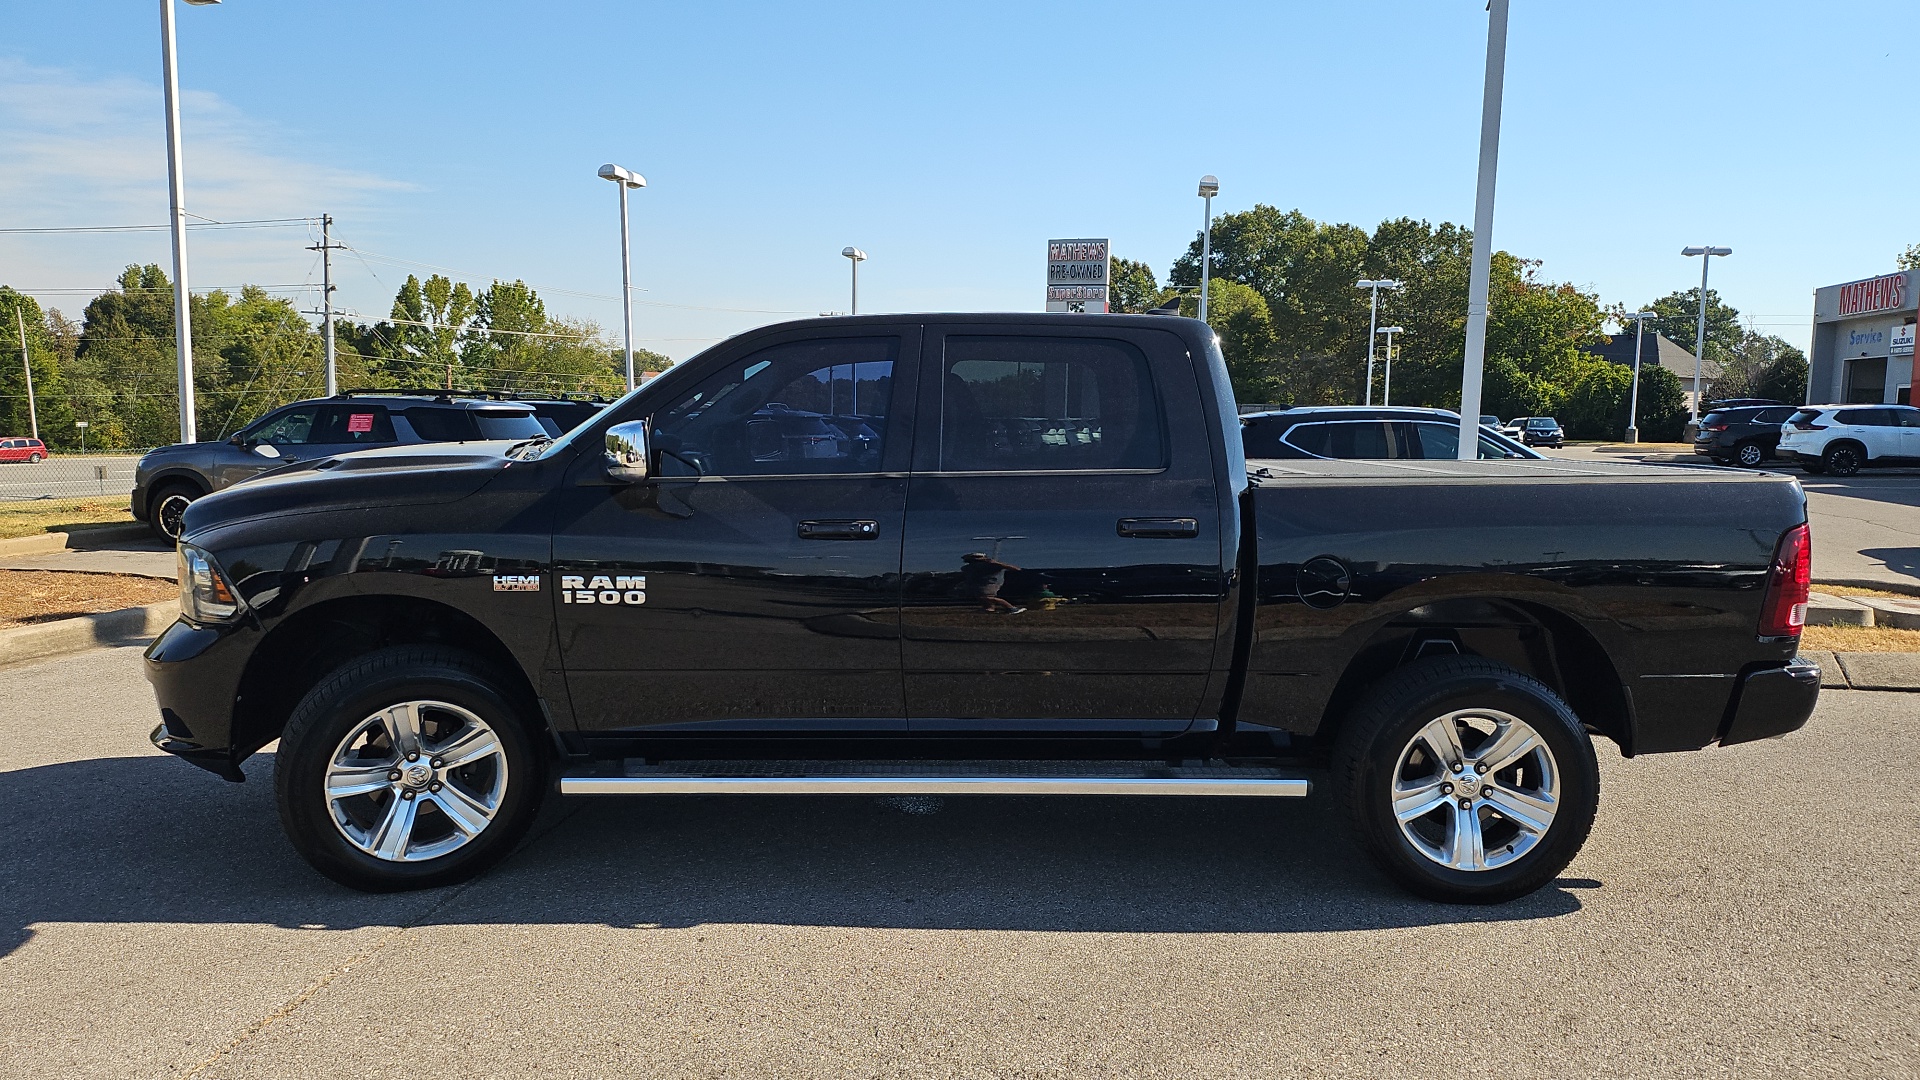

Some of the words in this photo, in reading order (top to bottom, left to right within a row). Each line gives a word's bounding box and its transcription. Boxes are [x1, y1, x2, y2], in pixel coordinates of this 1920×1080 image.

[1050, 243, 1105, 260] MATHEWS
[1050, 264, 1103, 279] PRE-OWNED
[1839, 274, 1905, 316] MATHEWS
[1849, 328, 1882, 345] Service
[1892, 337, 1914, 345] SUZUKI
[494, 575, 539, 584] HEMI
[561, 575, 646, 589] RAM
[562, 590, 646, 605] 1500
